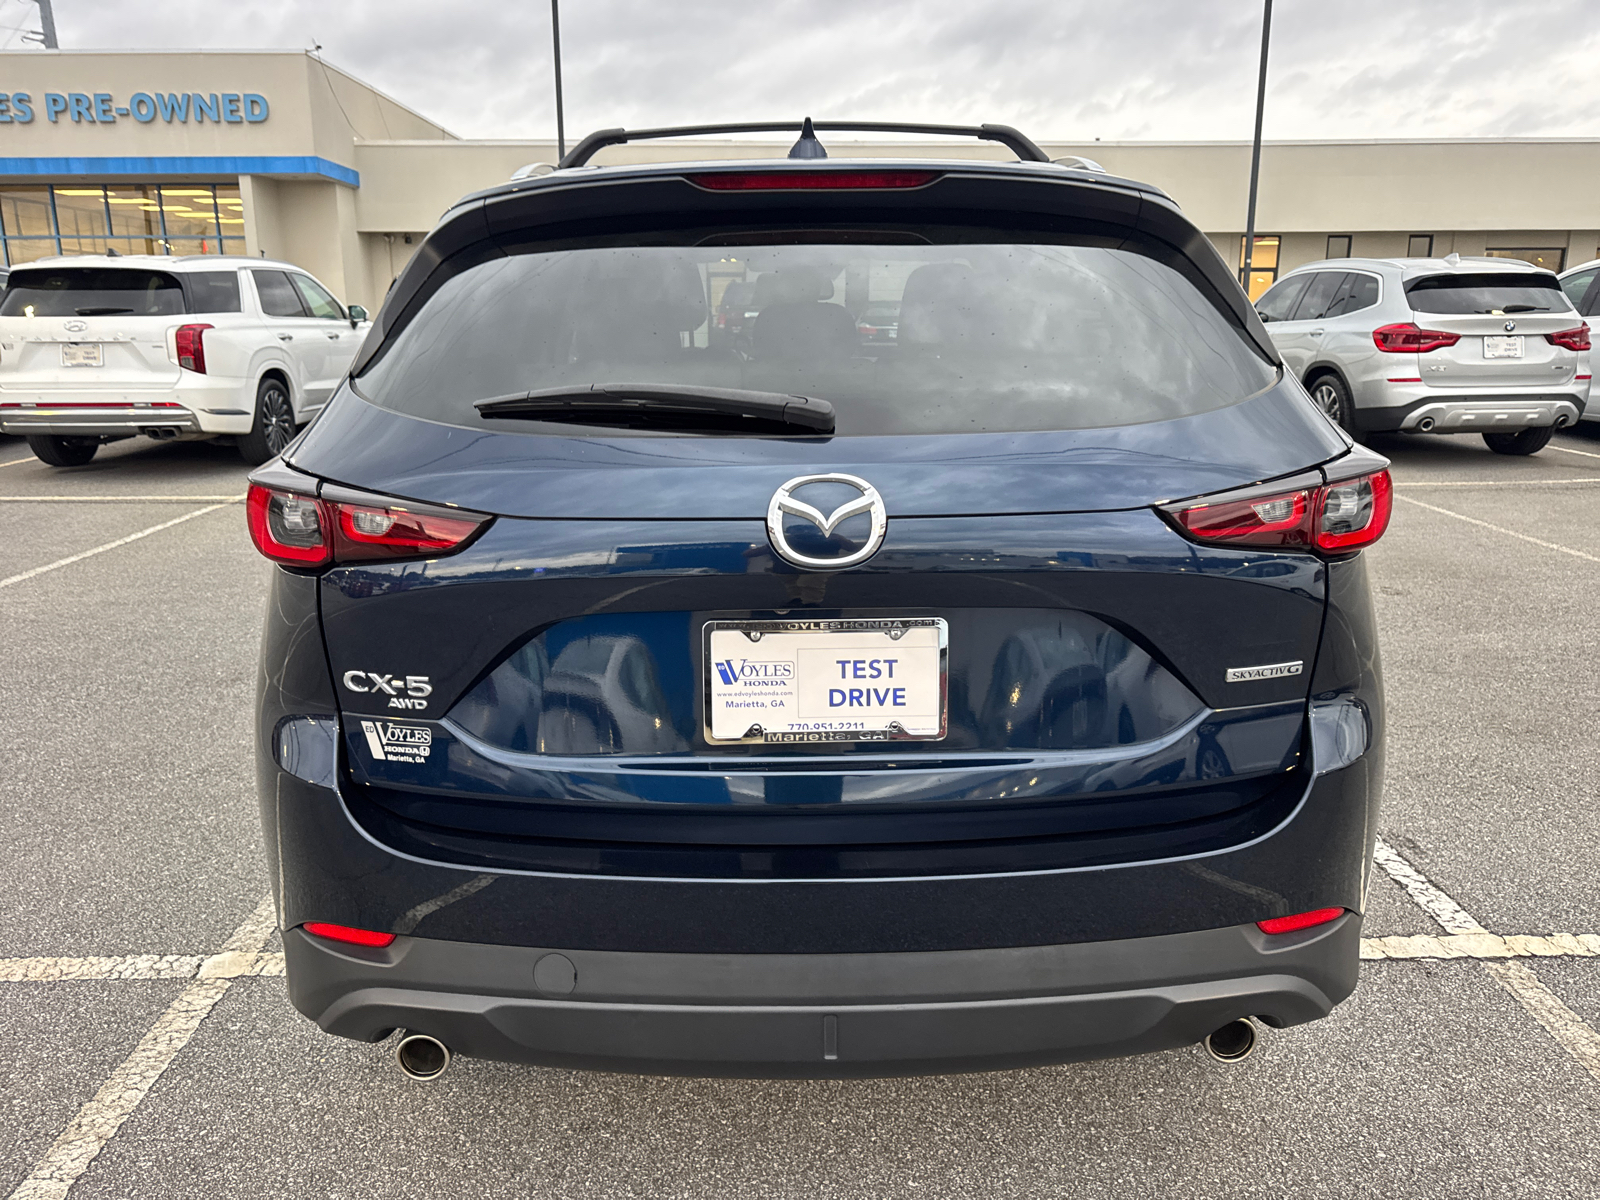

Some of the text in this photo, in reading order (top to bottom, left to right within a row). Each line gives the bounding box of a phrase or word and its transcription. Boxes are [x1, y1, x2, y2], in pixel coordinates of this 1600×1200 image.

[44, 92, 269, 124] PRE-OWNED
[724, 658, 791, 683] VOYLES
[836, 659, 899, 679] TEST
[343, 670, 433, 697] CX-5
[716, 690, 794, 698] www.edvoyleshonda.com
[828, 687, 907, 707] DRIVE
[387, 697, 428, 709] AWD
[725, 699, 786, 709] Marietta, GA
[365, 721, 430, 745] ED VOYLES
[858, 731, 886, 740] GA
[384, 745, 420, 754] HONDA
[387, 754, 415, 763] Marietta,
